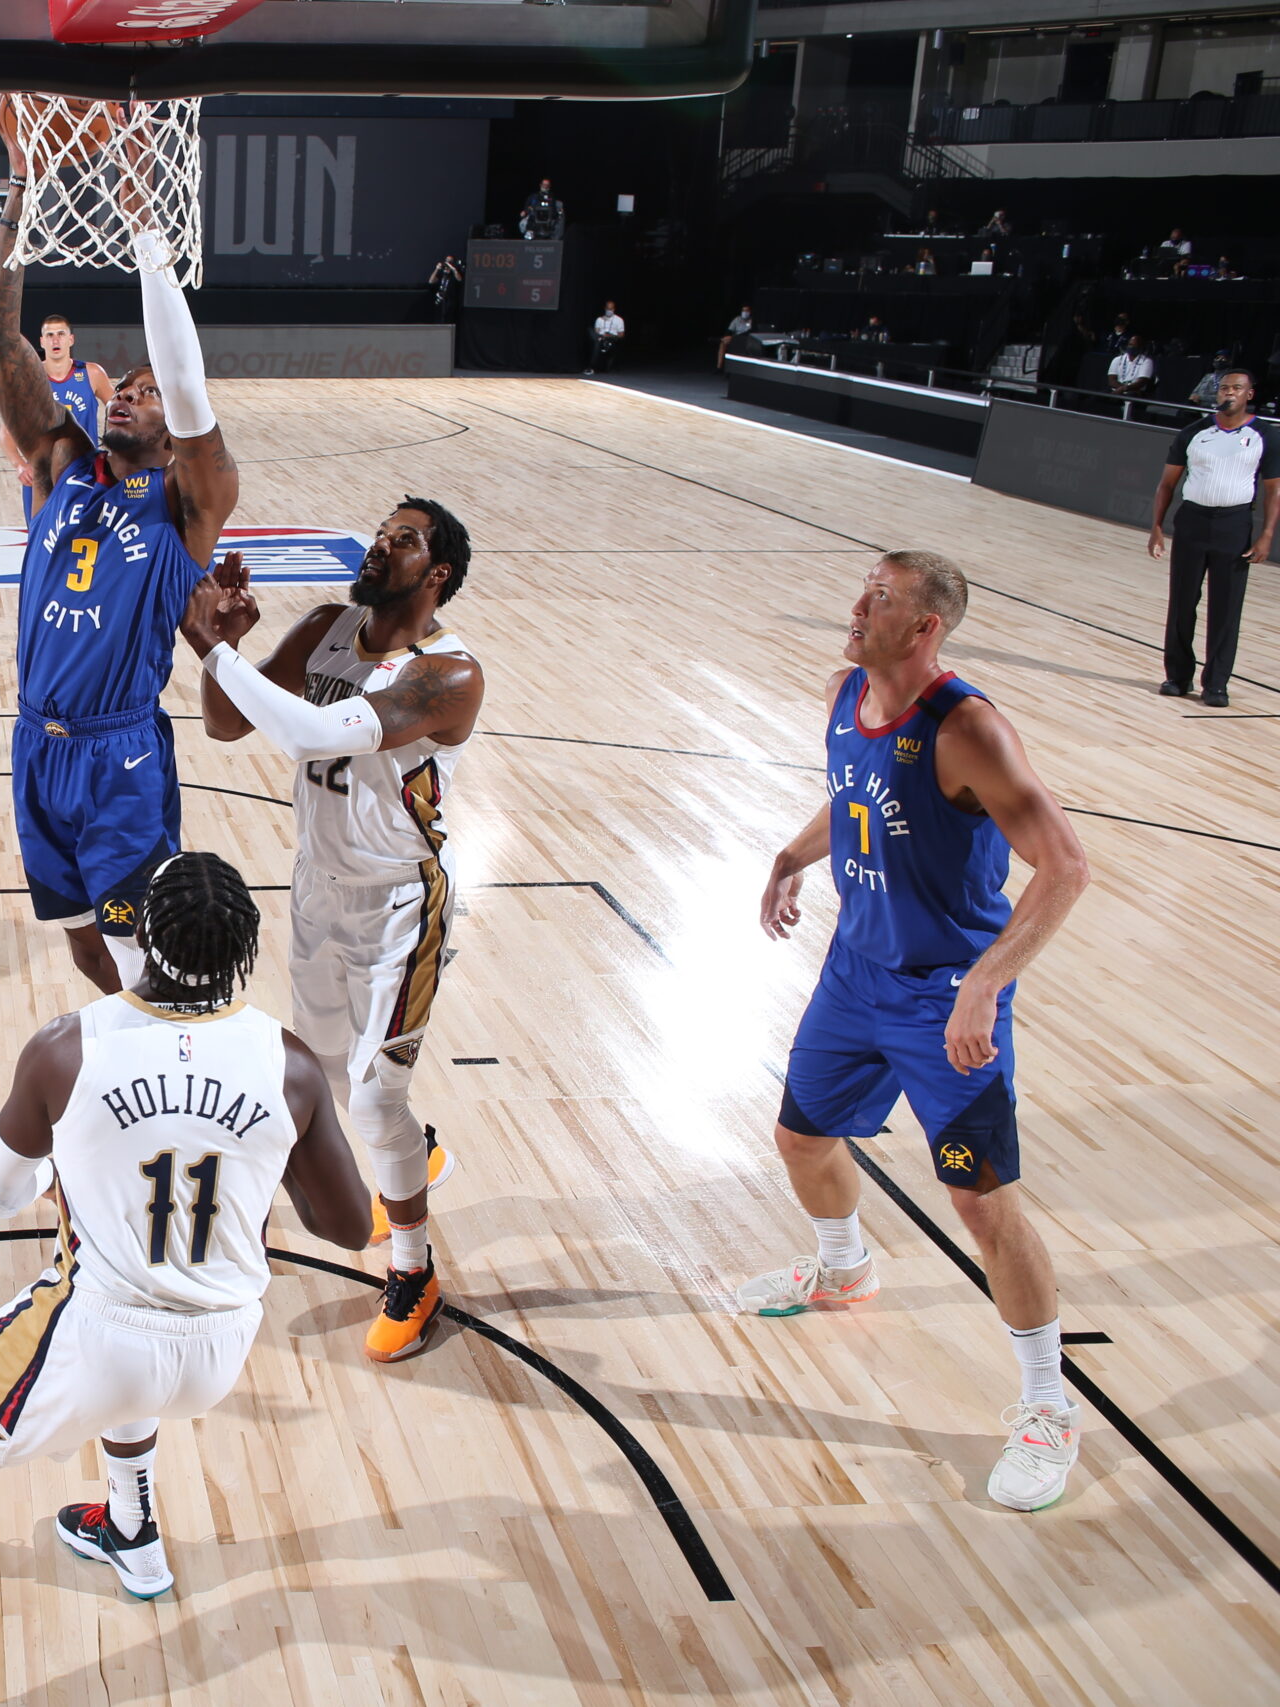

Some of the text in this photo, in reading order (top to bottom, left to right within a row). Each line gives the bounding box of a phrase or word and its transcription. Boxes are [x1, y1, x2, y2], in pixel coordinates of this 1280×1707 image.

[472, 253, 515, 268] 10:03
[533, 254, 543, 269] 5
[474, 285, 481, 299] 1
[531, 288, 541, 302] 5
[206, 351, 337, 377] OOTHIE
[65, 390, 87, 412] HIGH
[125, 474, 150, 489] WU
[42, 501, 149, 563] MILE HIGH
[65, 537, 99, 593] 3
[43, 599, 102, 633] CITY
[897, 736, 922, 753] WU
[827, 764, 911, 837] ILE HIGH
[847, 801, 870, 855] 7
[844, 858, 888, 894] CITY
[101, 1074, 271, 1140] HOLIDAY
[138, 1149, 223, 1269] 11
